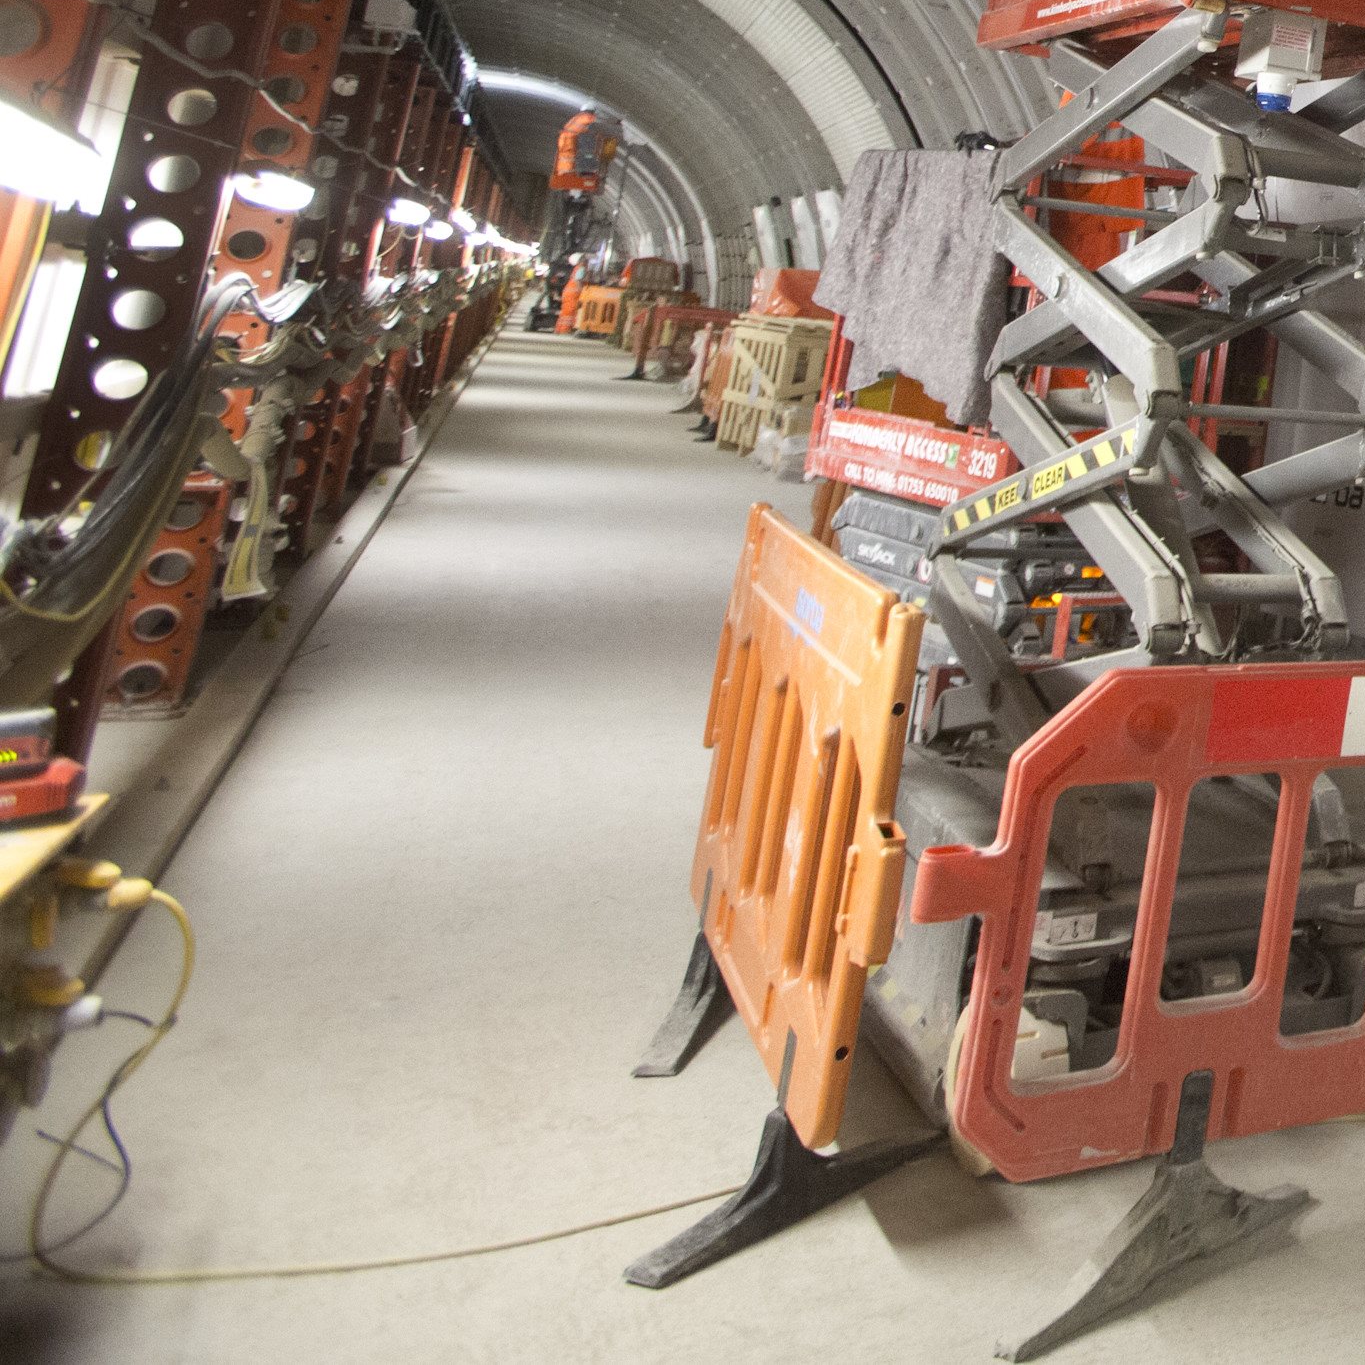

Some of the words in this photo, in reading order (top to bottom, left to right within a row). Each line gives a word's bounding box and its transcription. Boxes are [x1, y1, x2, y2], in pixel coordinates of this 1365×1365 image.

[904, 434, 949, 464] ACCESS
[967, 449, 997, 479] 3219
[844, 462, 862, 480] CALL
[863, 465, 875, 483] TO
[897, 475, 924, 495] 01753
[924, 482, 959, 503] 650010
[1033, 466, 1066, 493] CLEAR
